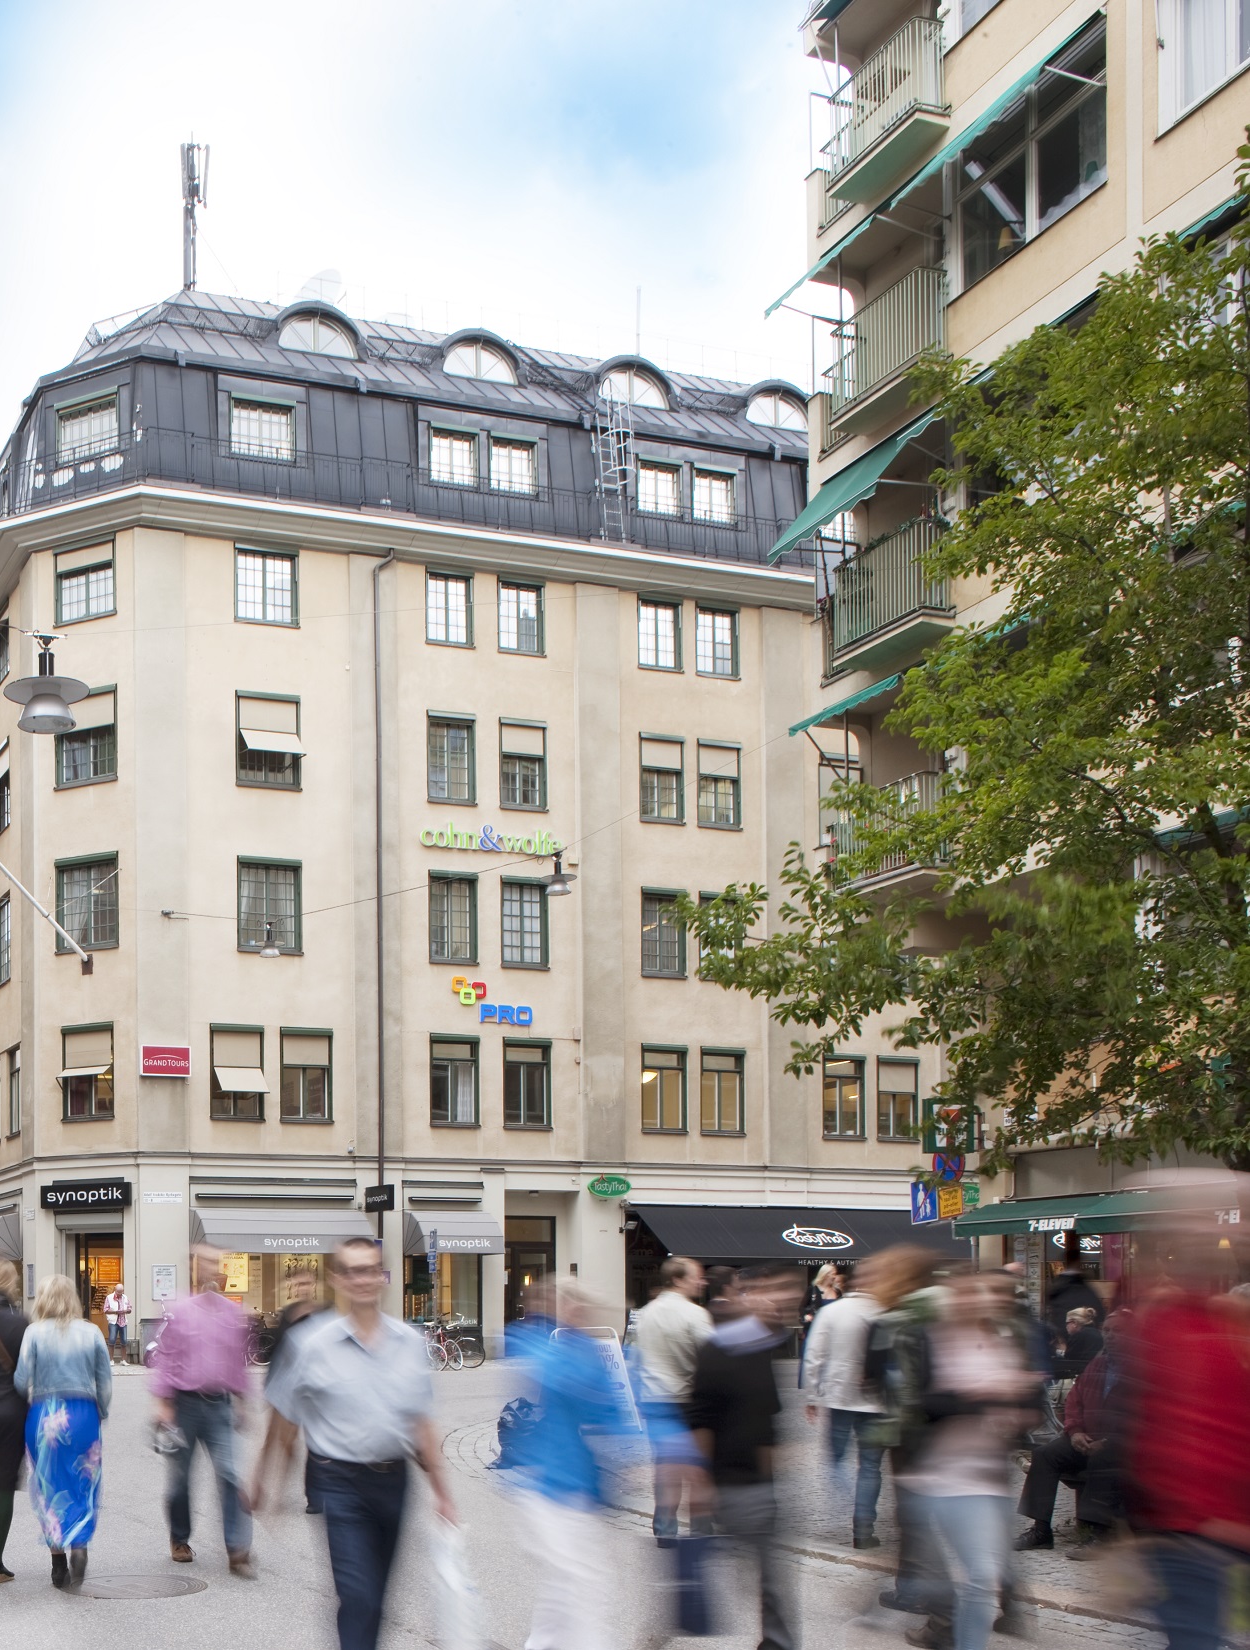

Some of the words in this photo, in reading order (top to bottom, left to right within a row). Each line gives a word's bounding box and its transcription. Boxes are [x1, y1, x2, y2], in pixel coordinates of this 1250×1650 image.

[479, 1003, 533, 1026] PRO
[46, 1187, 123, 1204] synoptik
[366, 1194, 388, 1204] synoptik
[264, 1237, 320, 1247] synoptik
[439, 1239, 491, 1249] synoptik
